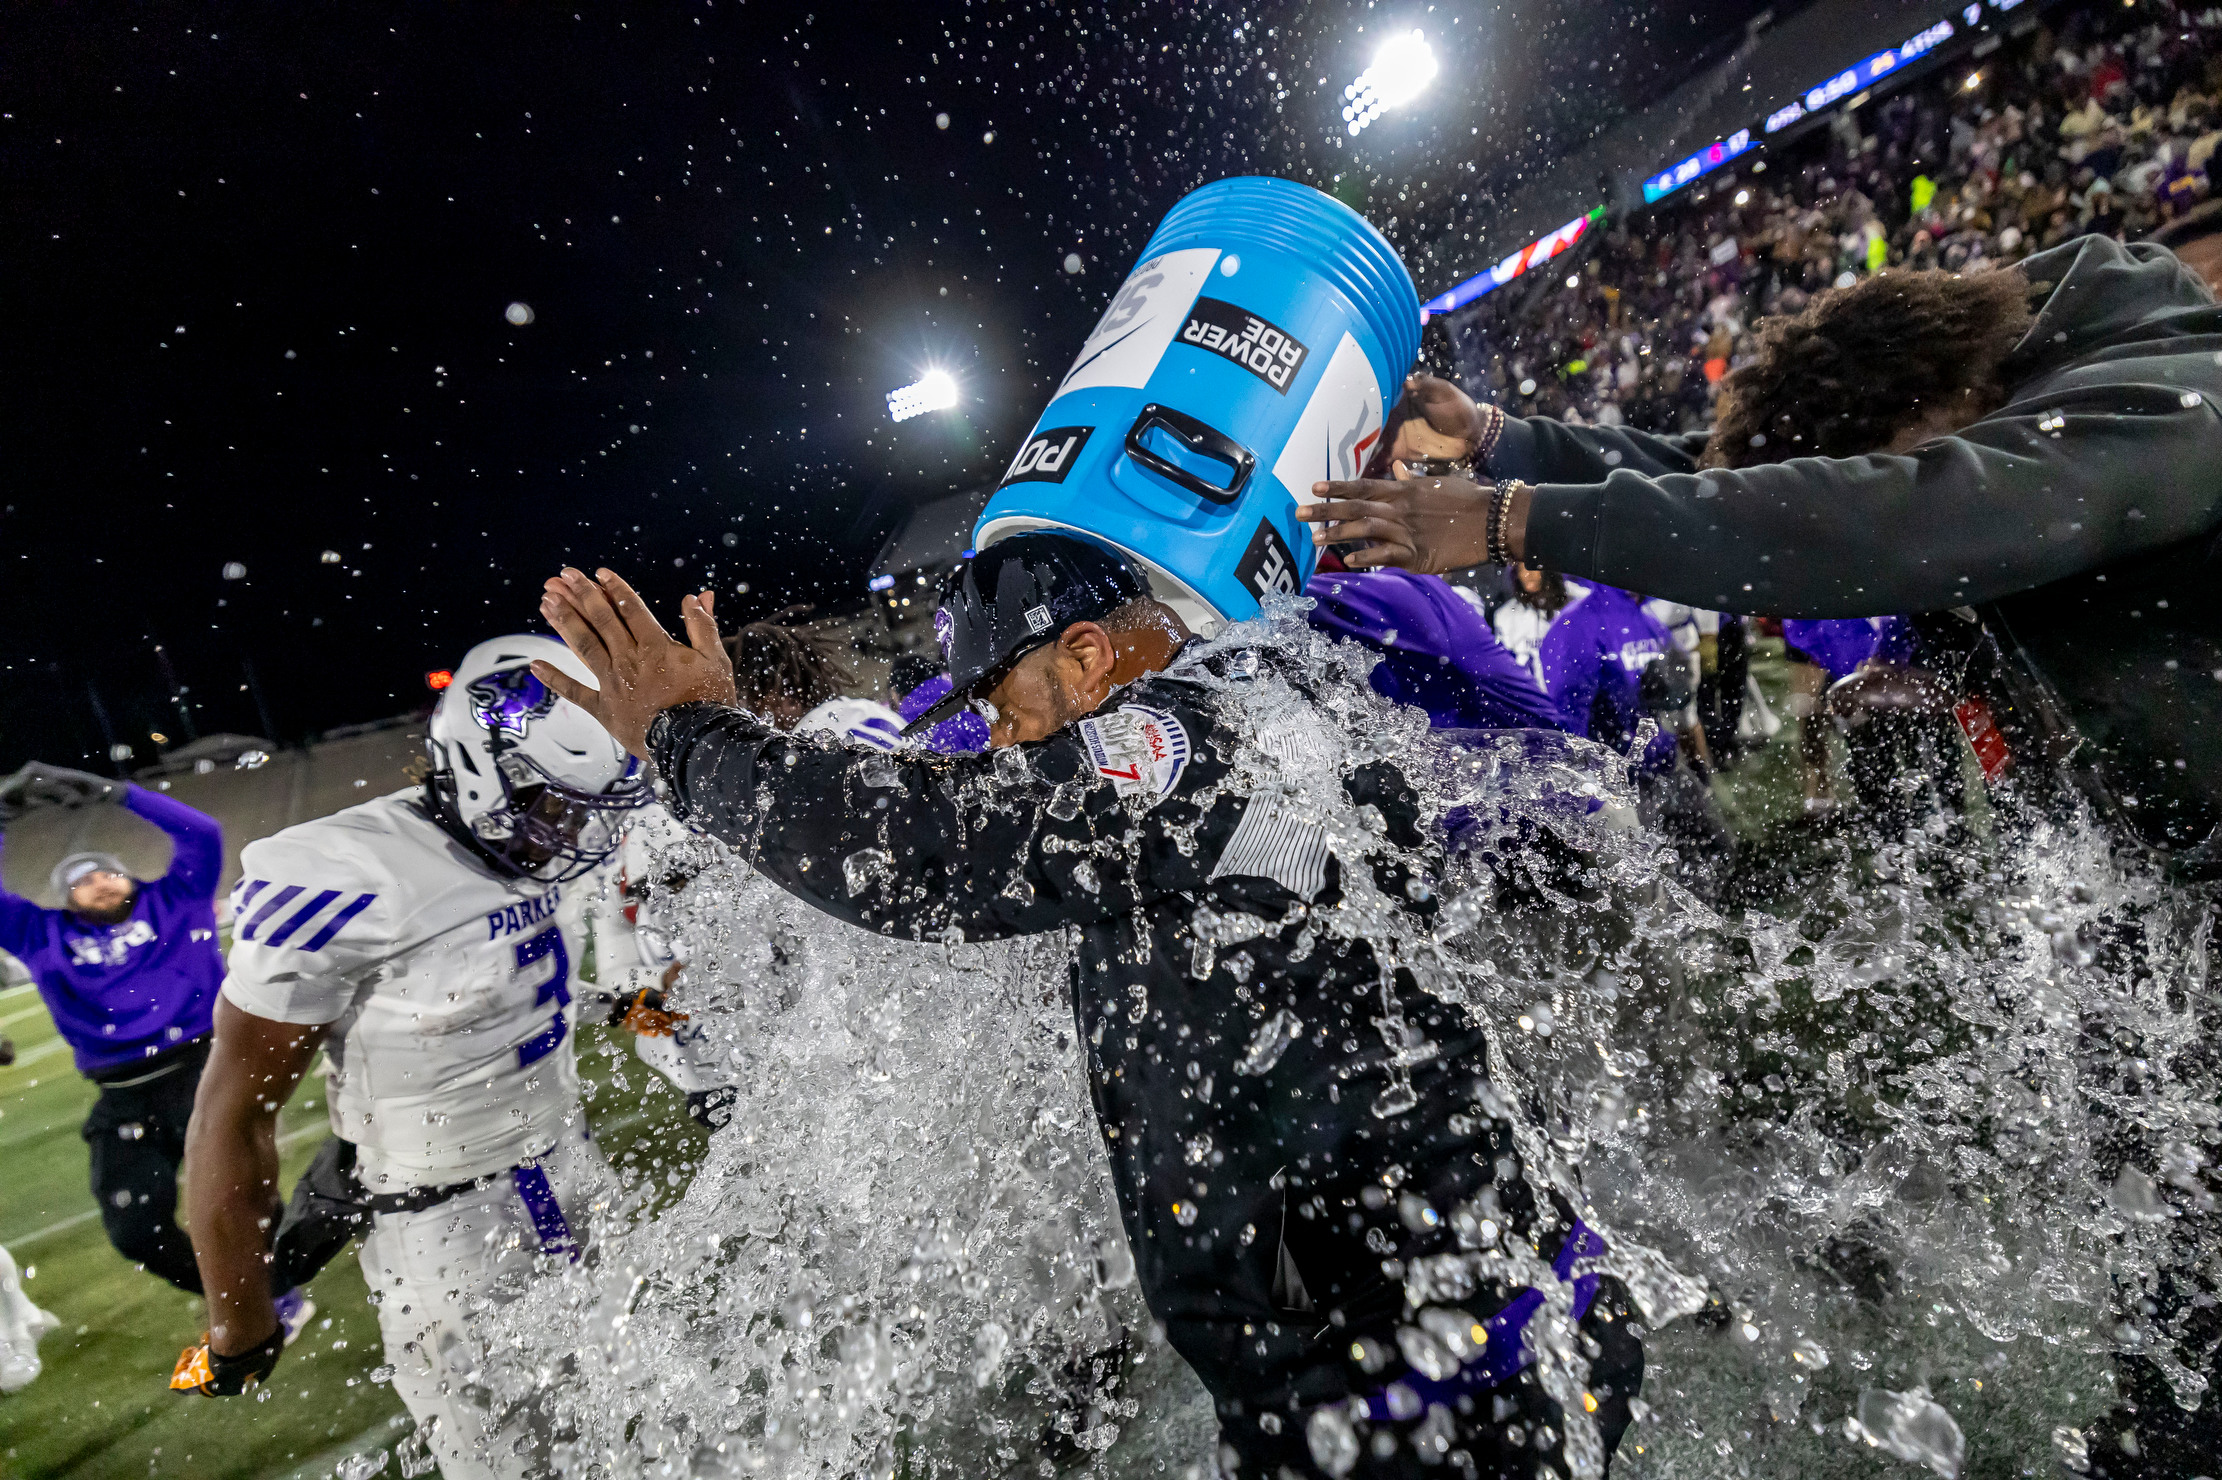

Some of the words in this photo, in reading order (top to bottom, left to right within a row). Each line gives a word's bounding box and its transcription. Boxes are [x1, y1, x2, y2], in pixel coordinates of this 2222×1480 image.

[1184, 319, 1292, 387] POWER
[1241, 317, 1302, 367] ADE
[1007, 436, 1077, 479] PO
[1253, 544, 1295, 596] DE
[515, 926, 571, 1068] 3
